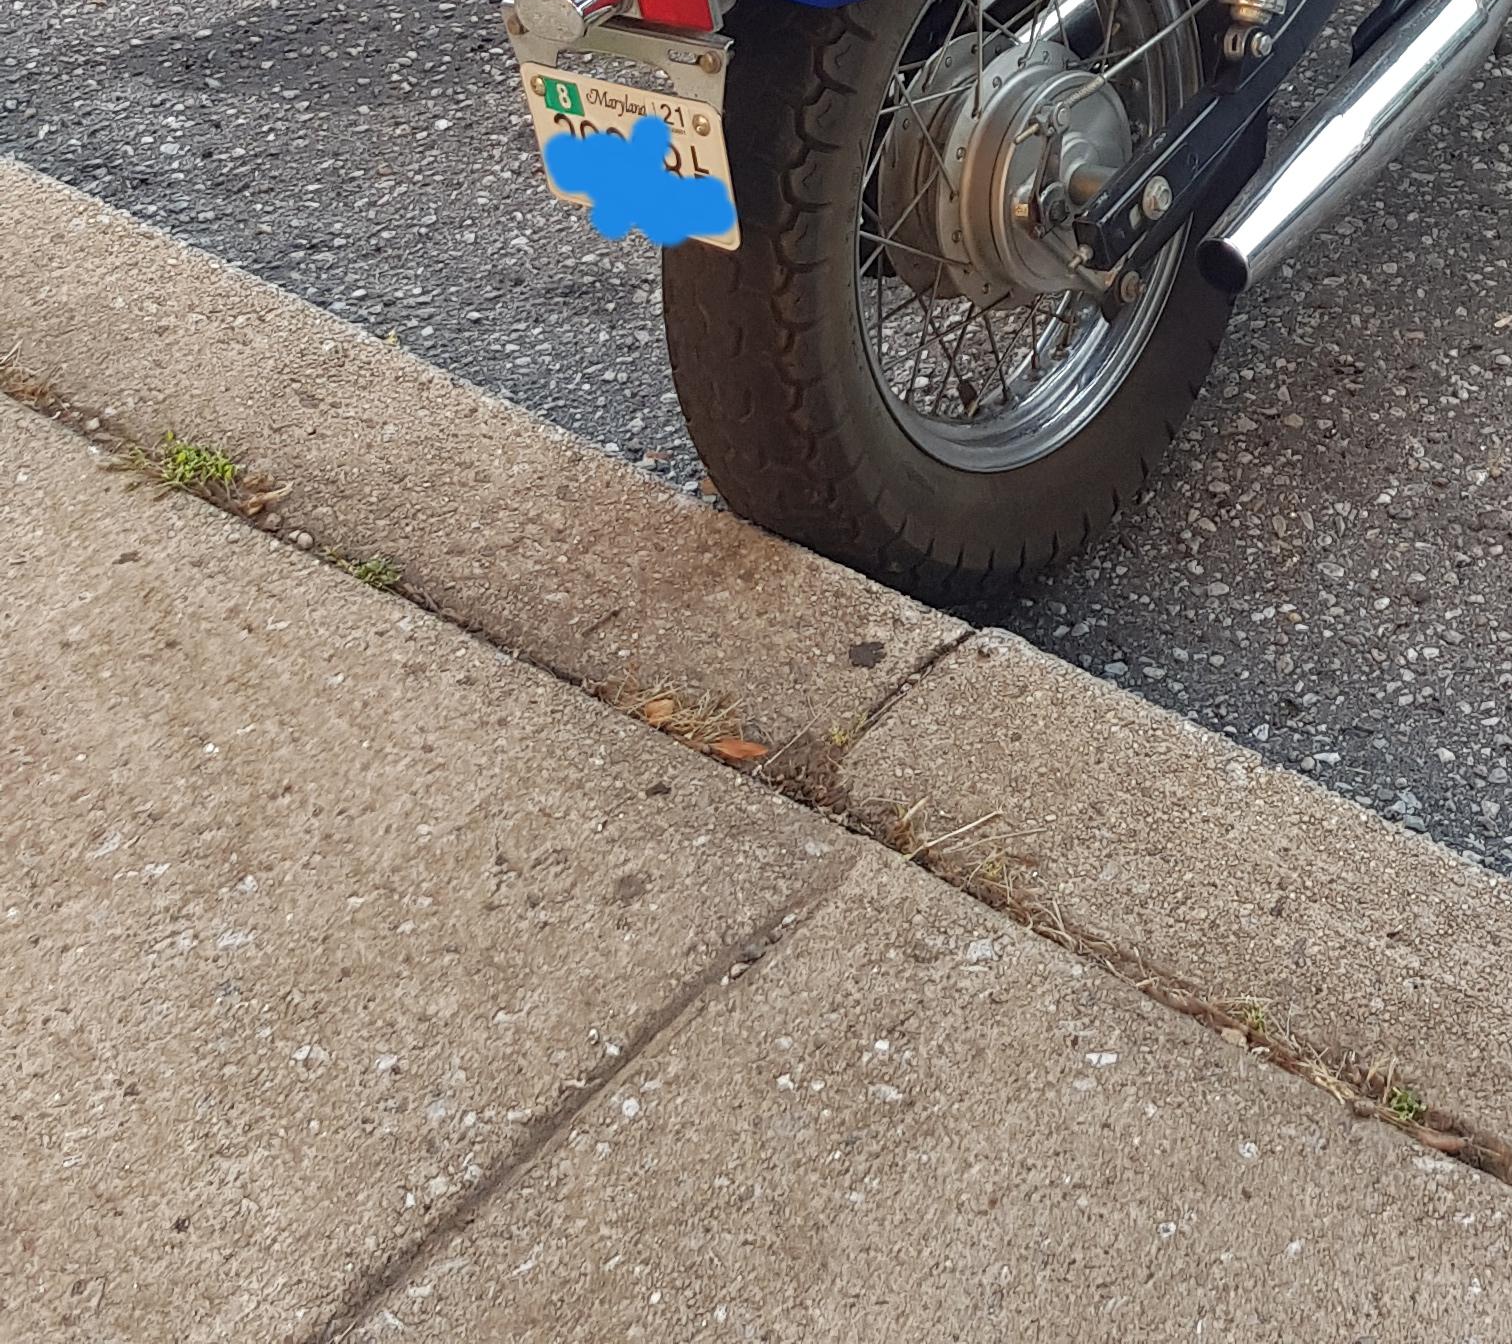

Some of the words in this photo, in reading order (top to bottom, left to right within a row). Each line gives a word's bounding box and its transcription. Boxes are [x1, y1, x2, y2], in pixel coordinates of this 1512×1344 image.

[556, 83, 572, 110] 8
[586, 89, 647, 117] Maryland
[660, 102, 685, 128] 21
